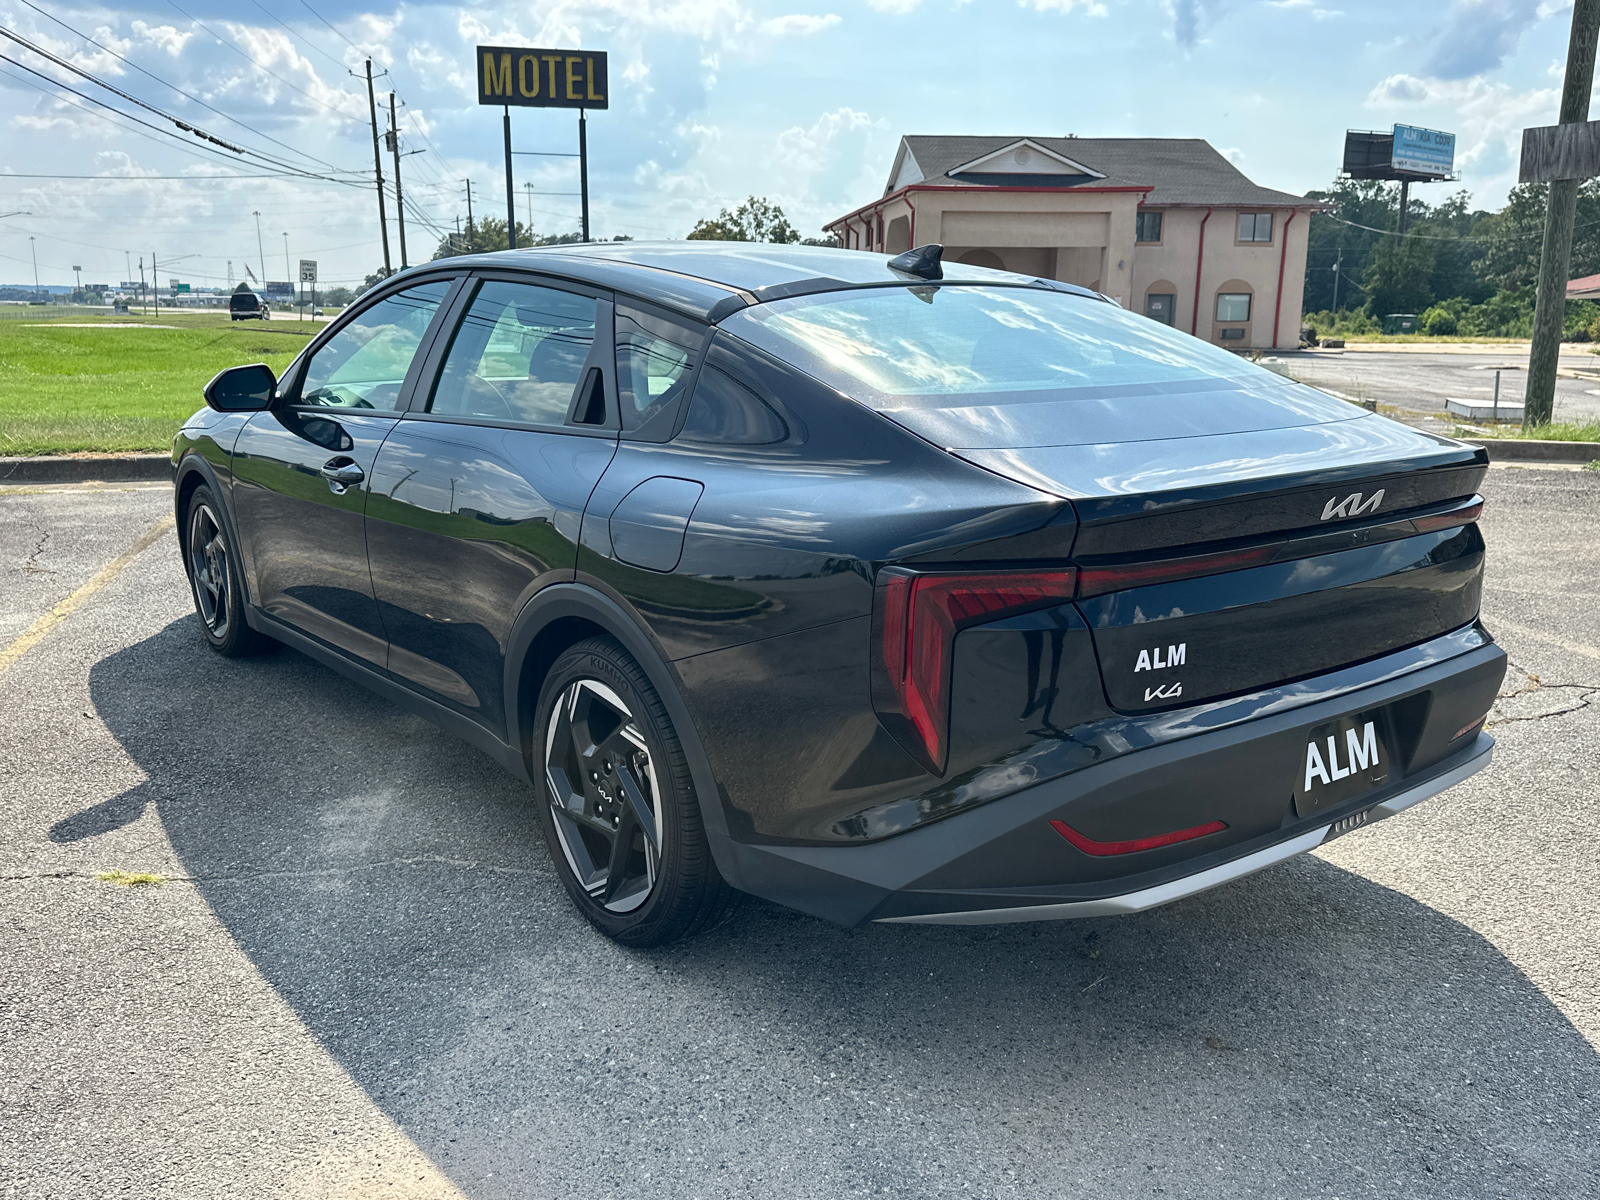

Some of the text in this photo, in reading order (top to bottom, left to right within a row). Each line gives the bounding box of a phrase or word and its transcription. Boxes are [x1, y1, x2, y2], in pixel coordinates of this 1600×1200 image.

[483, 52, 604, 100] MOTEL
[1402, 129, 1417, 141] ALM
[1420, 132, 1431, 143] KIA
[302, 272, 315, 281] 35
[1134, 643, 1187, 673] ALM
[590, 656, 629, 692] KUMHO
[1144, 682, 1182, 702] K4
[1304, 721, 1379, 792] ALM
